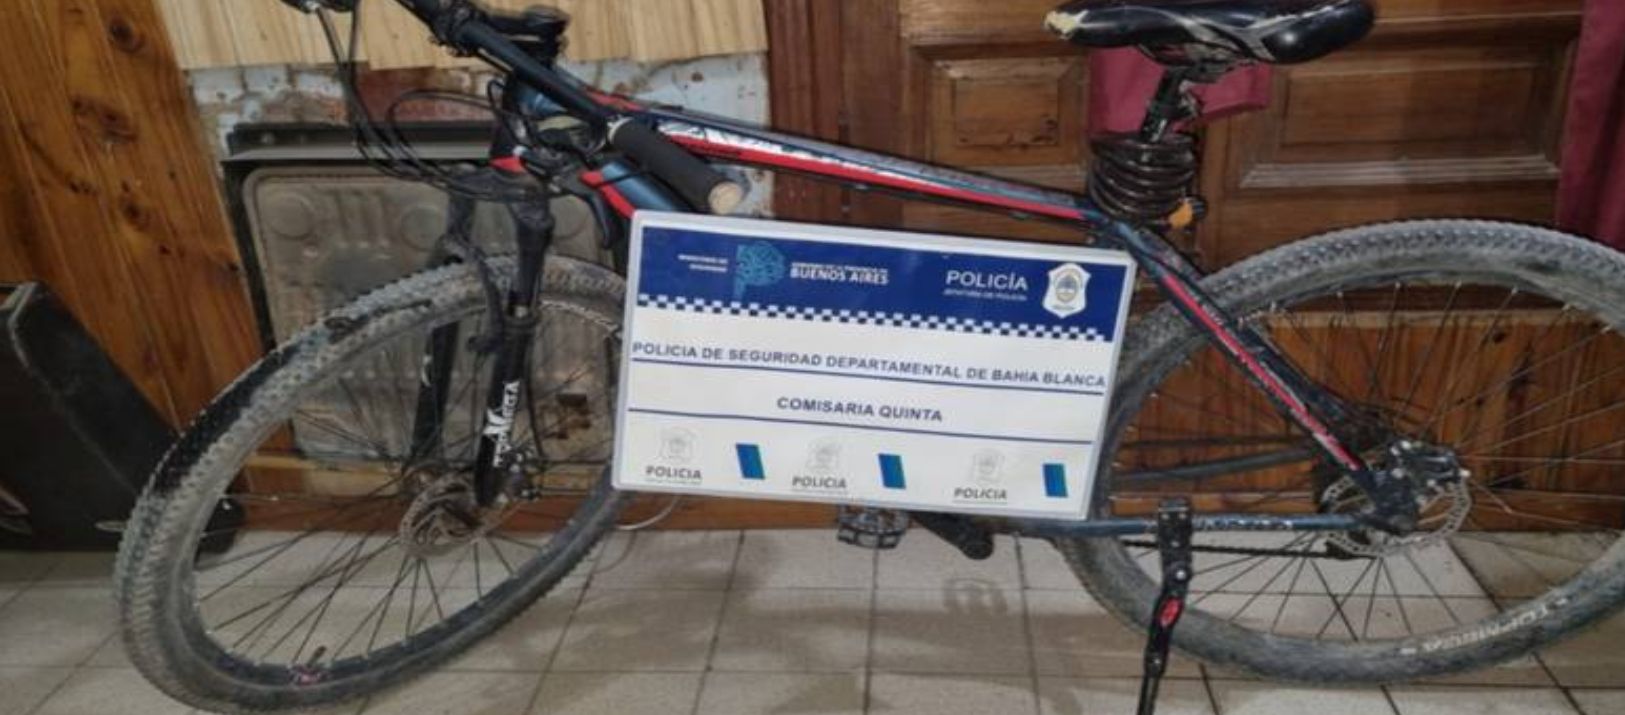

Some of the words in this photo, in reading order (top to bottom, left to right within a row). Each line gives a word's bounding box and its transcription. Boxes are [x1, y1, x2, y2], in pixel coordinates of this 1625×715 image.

[790, 266, 846, 281] BUENOS
[849, 272, 889, 285] AIRES
[946, 270, 1028, 291] POLICÍA
[632, 342, 697, 358] POLICIA
[702, 347, 724, 360] DE
[729, 349, 822, 366] SEGURIDAD
[826, 357, 962, 379] DEPARTAMENTAL
[966, 367, 988, 379] DE
[991, 369, 1039, 383] BAHIA
[1042, 372, 1106, 387] BLANCA
[776, 397, 873, 415] COMISARIA
[879, 405, 943, 422] QUINTA
[645, 465, 702, 480] POLICIA
[792, 475, 847, 489] POLICIA
[953, 487, 1008, 500] POLICIA
